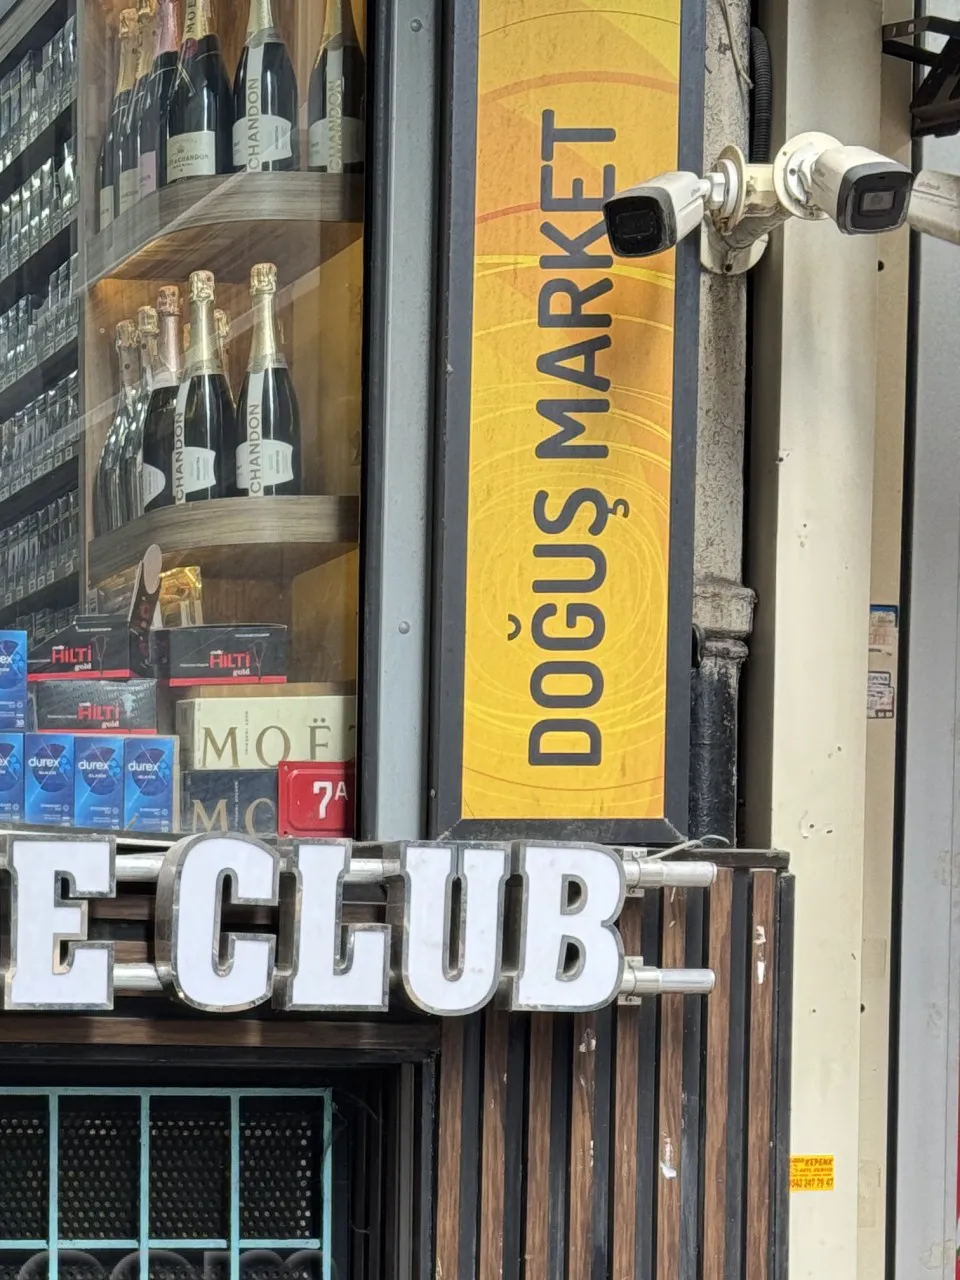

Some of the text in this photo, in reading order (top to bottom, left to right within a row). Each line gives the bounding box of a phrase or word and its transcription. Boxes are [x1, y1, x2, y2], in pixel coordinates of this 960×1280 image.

[247, 78, 261, 170] CHANDON
[328, 81, 342, 172] CHANDON
[174, 412, 184, 501] CHANDON
[248, 403, 262, 494] CHANDON
[507, 109, 630, 766] DOĞUŞ MARKET
[232, 668, 251, 677] gold
[28, 756, 60, 768] durex
[78, 759, 109, 771] durex
[128, 760, 160, 772] durex
[202, 718, 355, 768] MOË
[155, 832, 627, 1016] CLUB
